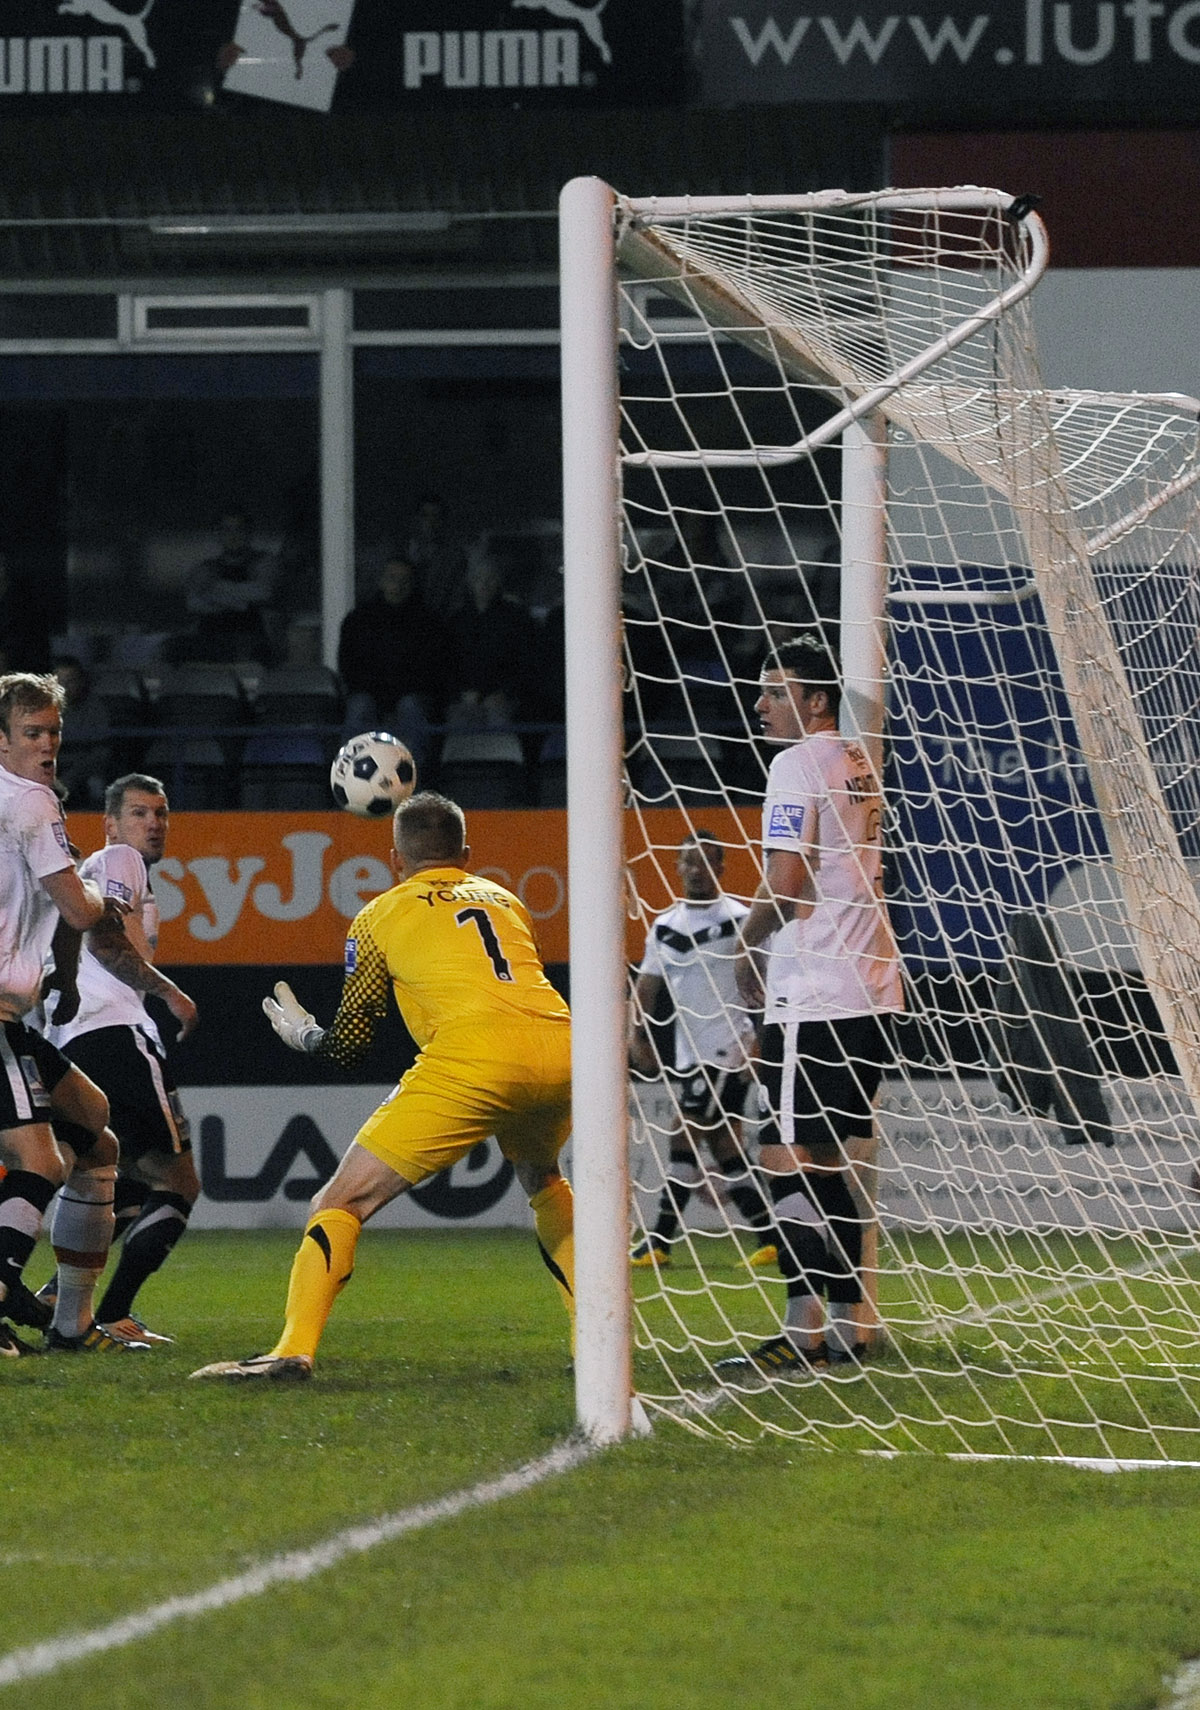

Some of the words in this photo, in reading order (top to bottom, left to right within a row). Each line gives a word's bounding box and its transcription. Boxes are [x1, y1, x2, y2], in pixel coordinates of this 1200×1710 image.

[404, 30, 578, 87] PUMA
[417, 890, 511, 908] YOUNG
[455, 907, 516, 983] 1
